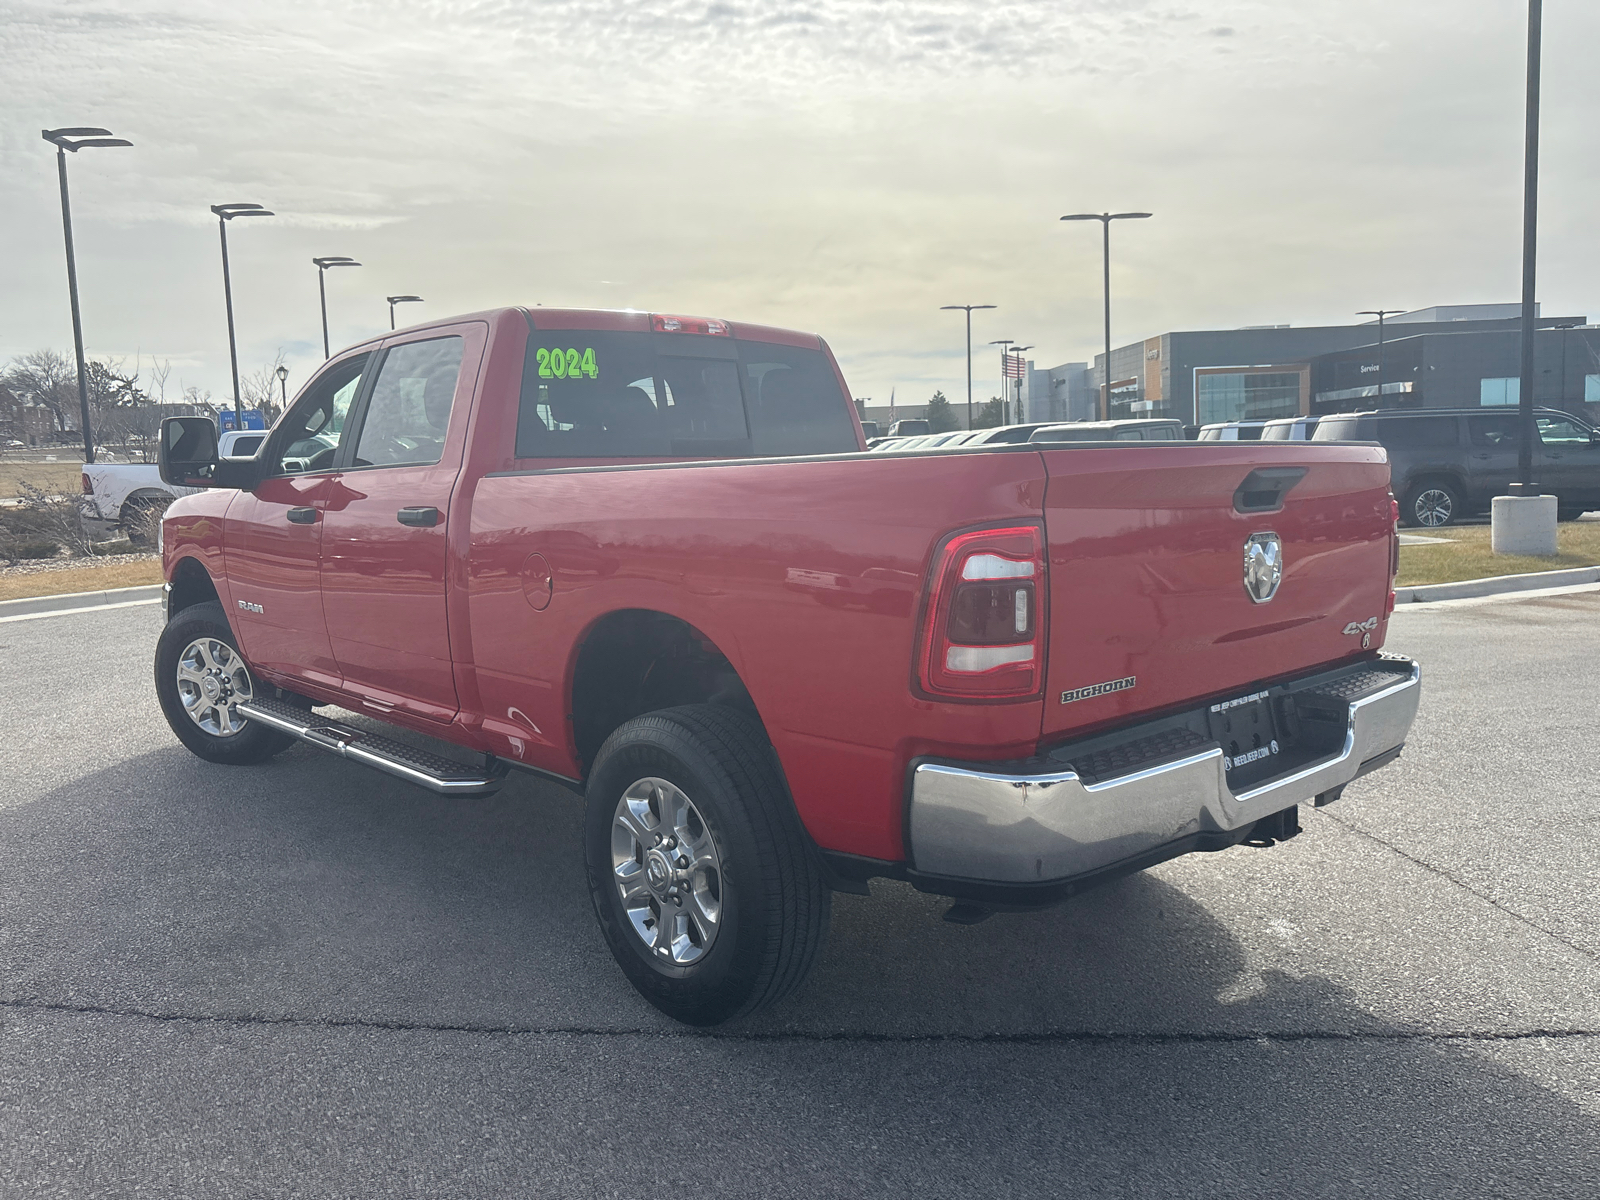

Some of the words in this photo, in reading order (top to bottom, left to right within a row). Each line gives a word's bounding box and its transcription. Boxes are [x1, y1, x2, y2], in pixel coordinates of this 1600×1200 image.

[536, 347, 599, 379] 2024
[1360, 363, 1380, 373] Service
[238, 600, 264, 614] RAM
[1061, 675, 1136, 704] BIGHORN
[1233, 746, 1270, 767] REEDJEEP.COM
